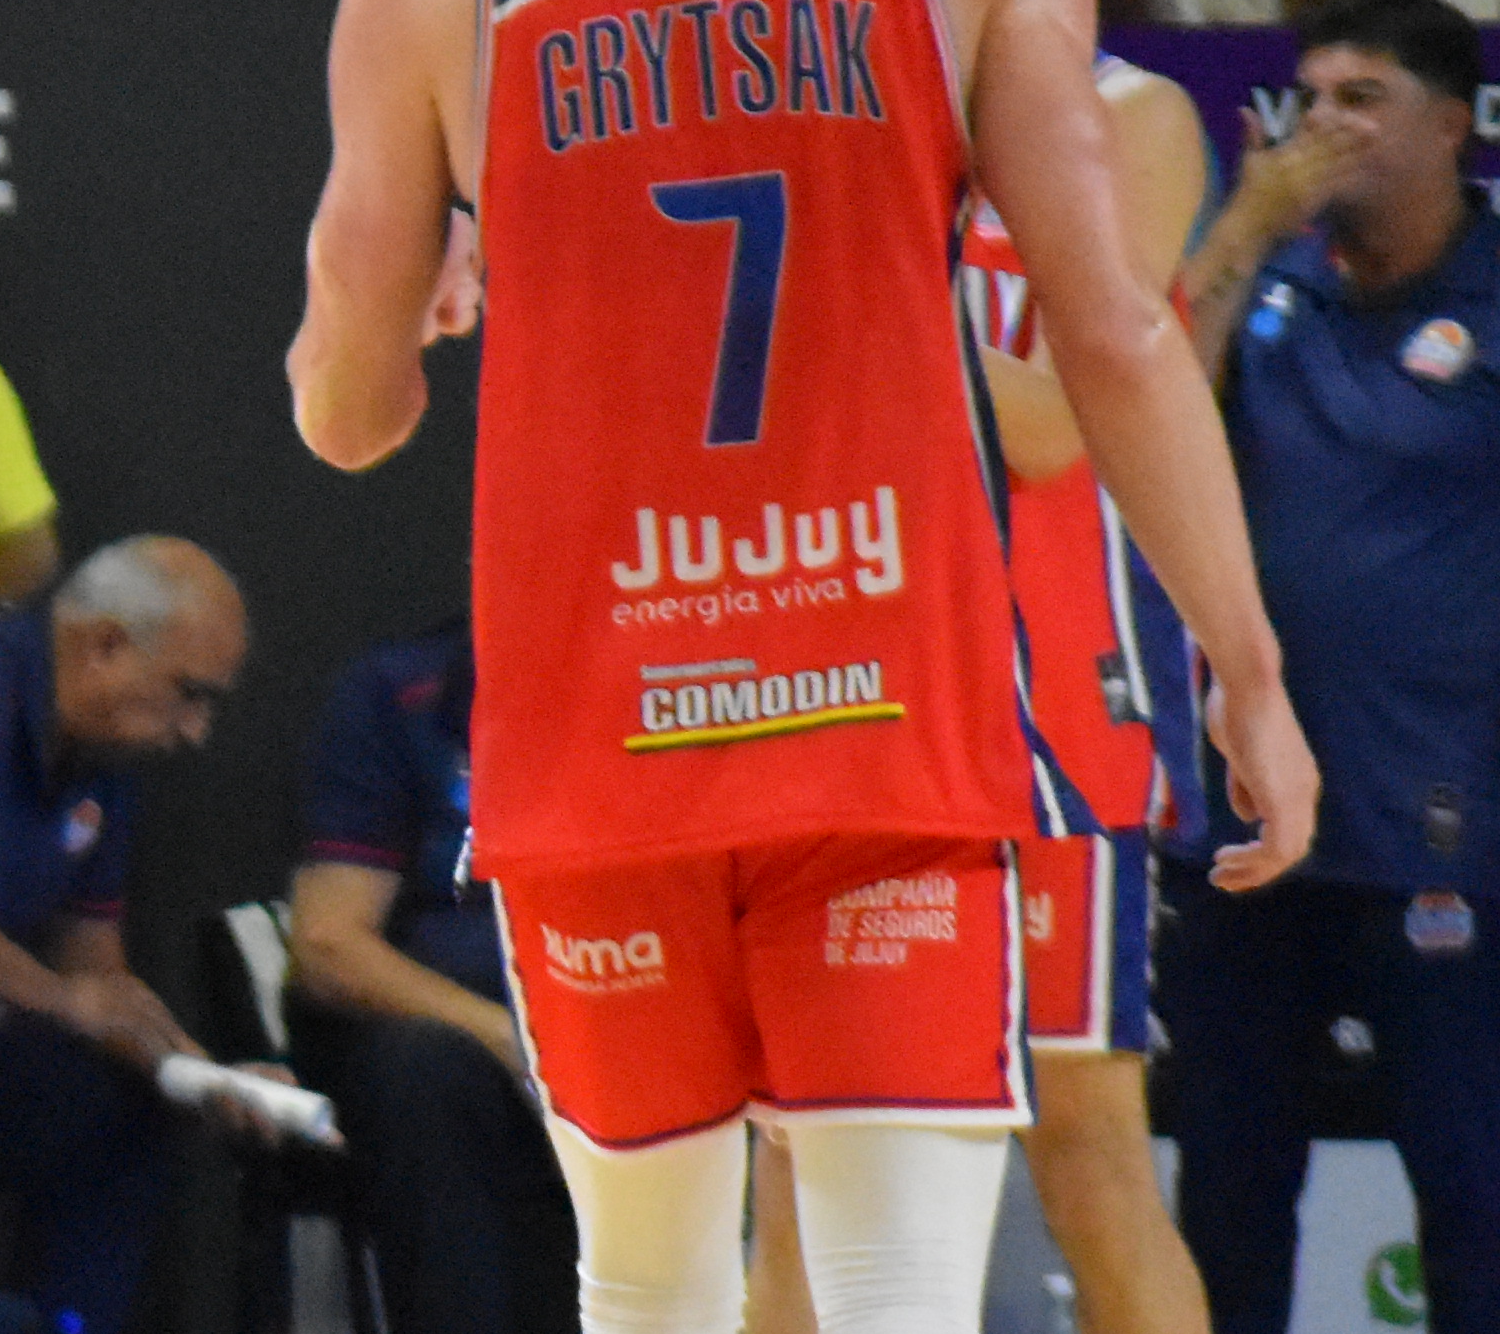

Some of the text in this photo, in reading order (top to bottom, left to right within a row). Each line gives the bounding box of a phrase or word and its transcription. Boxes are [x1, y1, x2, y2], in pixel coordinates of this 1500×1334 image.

[648, 169, 790, 447] 7
[771, 577, 846, 610] viva
[639, 660, 882, 732] COMODIN
